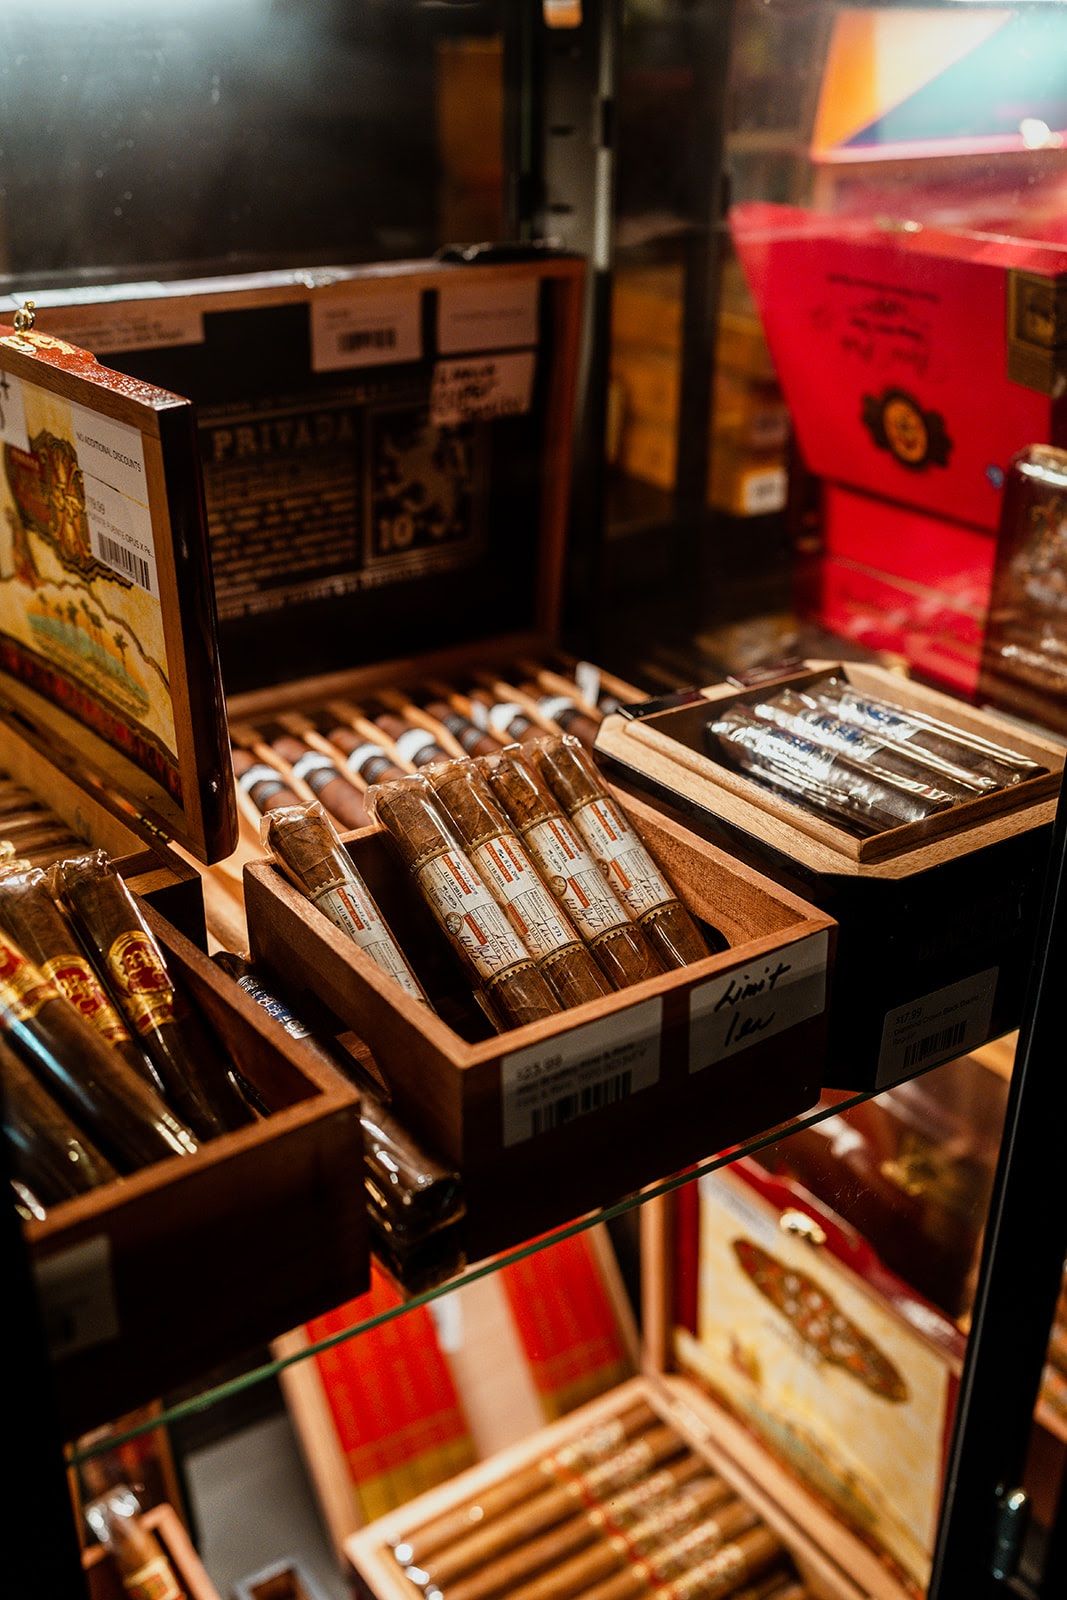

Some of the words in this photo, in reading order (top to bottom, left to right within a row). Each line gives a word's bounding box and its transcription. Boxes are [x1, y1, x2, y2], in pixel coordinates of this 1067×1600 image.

[213, 414, 354, 460] PRIVADA
[85, 436, 112, 458] ADDITIONAL
[112, 449, 141, 473] DISCOUNTS
[125, 533, 139, 549] OPUS
[485, 843, 502, 867] RELEASE
[442, 855, 460, 878] RELEASE
[457, 877, 470, 894] DATE:
[443, 870, 463, 899] 11/18/2016
[486, 859, 505, 887] 11/18/2016
[335, 904, 357, 934] 11/18/2016
[714, 963, 792, 1013] Limit
